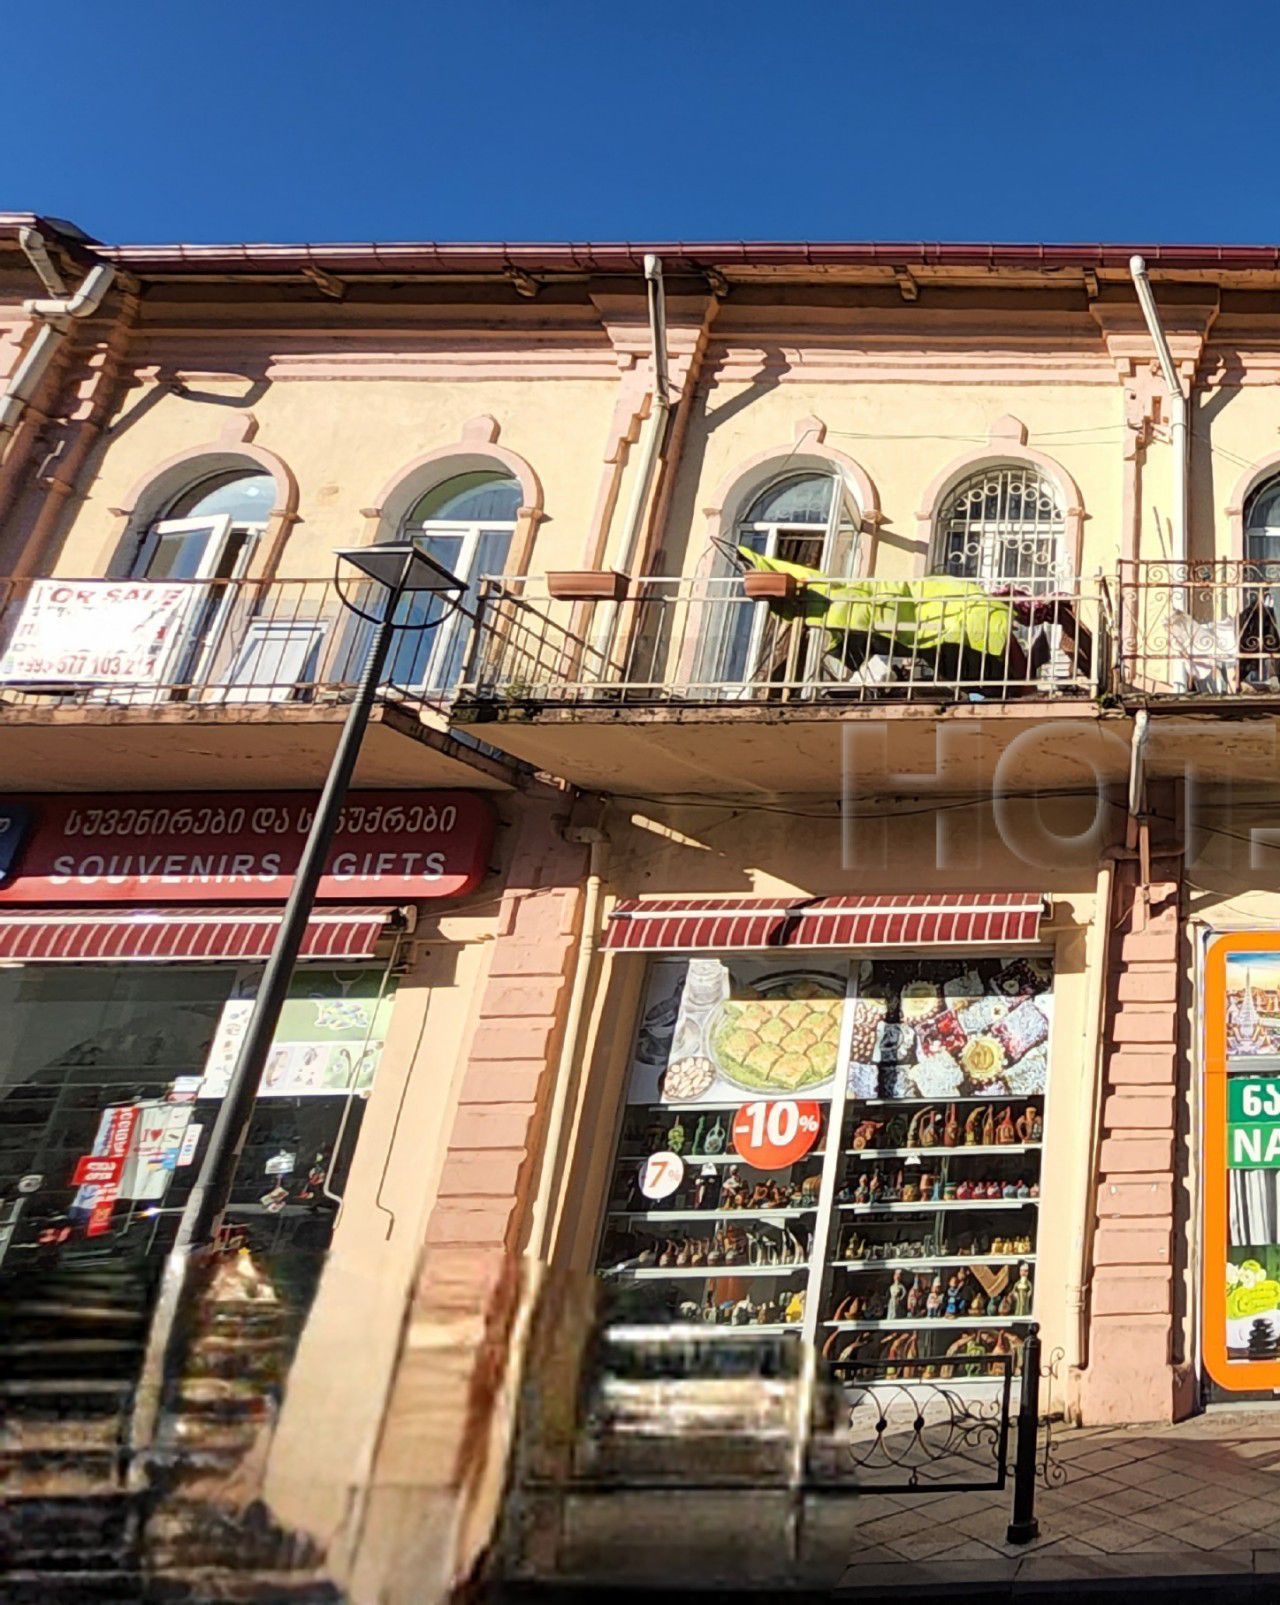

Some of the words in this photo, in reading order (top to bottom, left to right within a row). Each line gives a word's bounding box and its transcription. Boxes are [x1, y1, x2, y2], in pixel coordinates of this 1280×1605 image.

[124, 658, 158, 676] 21
[64, 808, 245, 836] სუვენირები
[252, 807, 290, 834] და
[297, 805, 457, 834] სჩუქრები
[50, 854, 281, 885] SOUVENIRS
[332, 852, 446, 882] GIFTS
[734, 1101, 820, 1149] -10%
